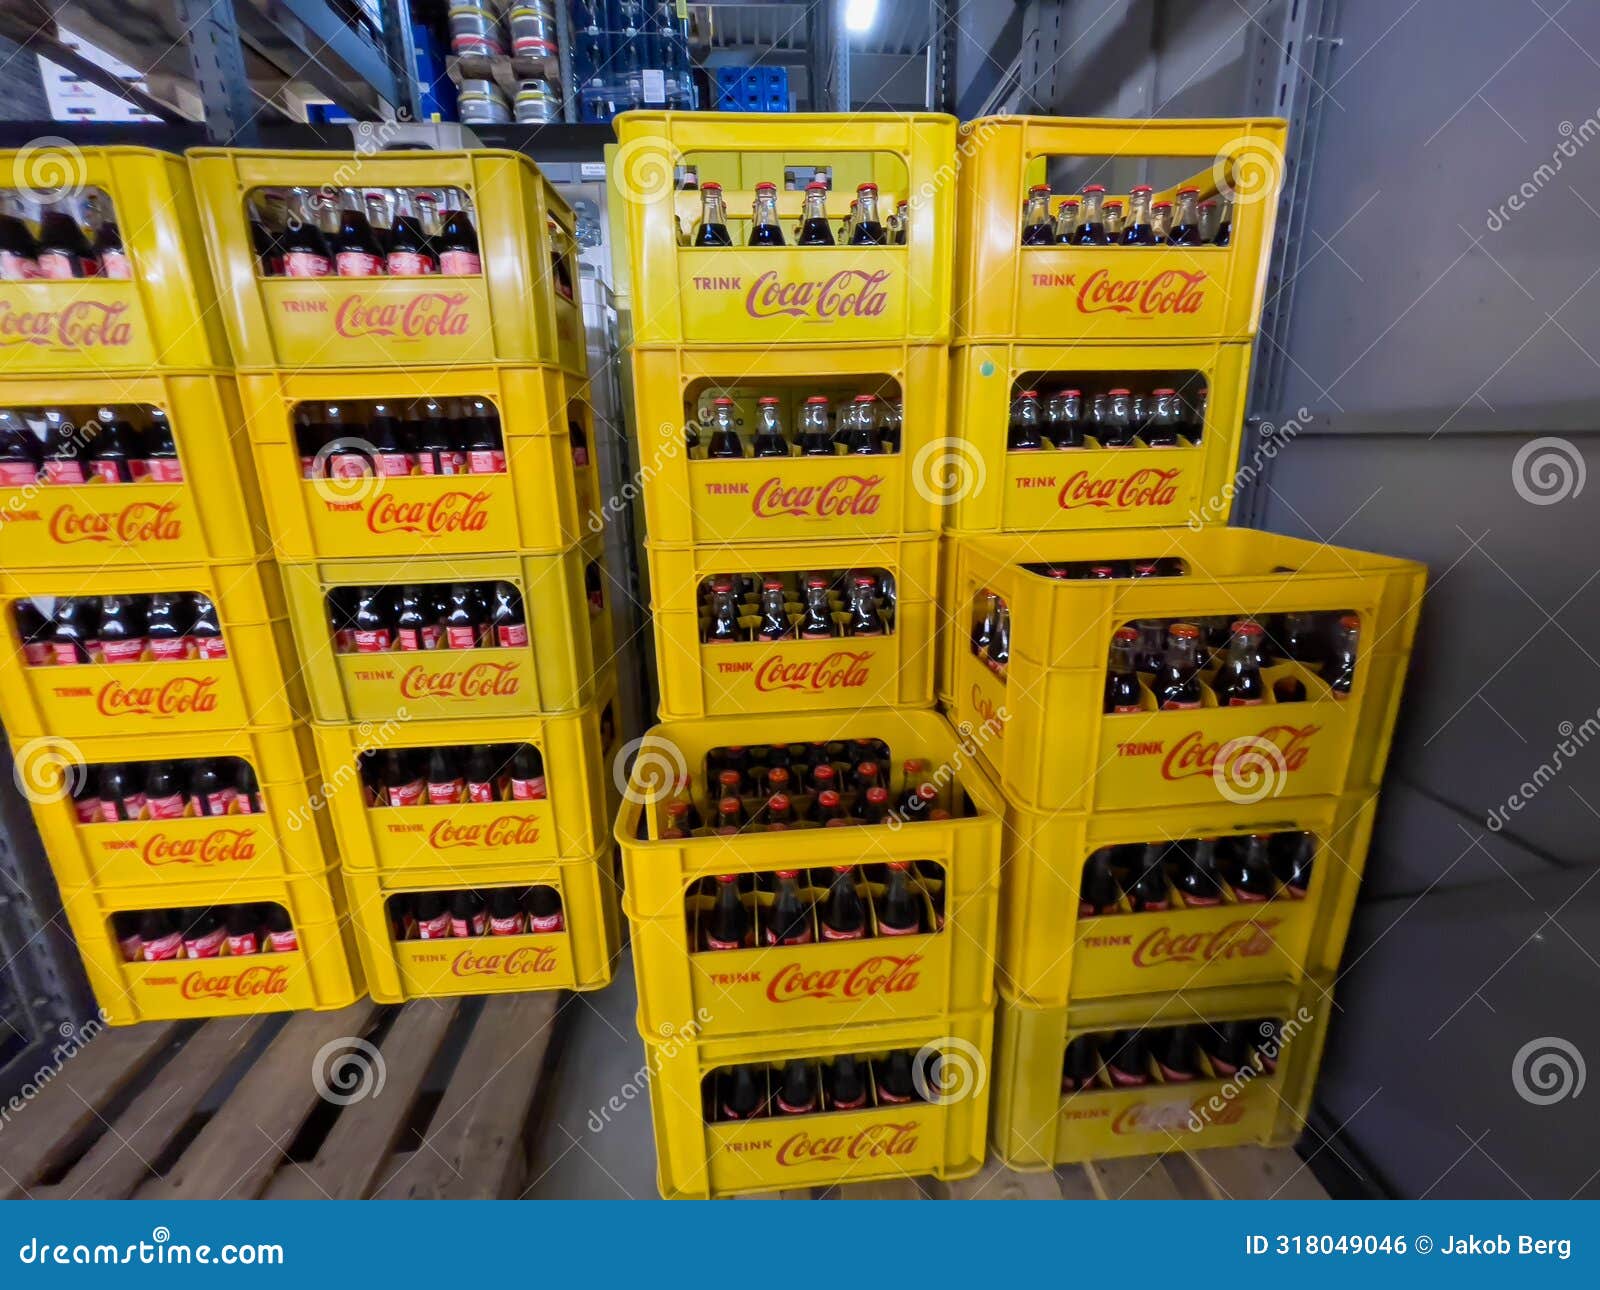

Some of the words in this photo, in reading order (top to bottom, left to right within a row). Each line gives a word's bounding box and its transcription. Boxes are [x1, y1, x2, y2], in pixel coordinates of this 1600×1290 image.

[692, 276, 742, 291] TRINK
[746, 269, 891, 319] Coca-Cola
[1032, 273, 1077, 287] TRINK
[1076, 268, 1209, 315] Coca-Cola
[0, 300, 131, 347] oca-Cola
[281, 300, 329, 313] TRINK
[335, 292, 470, 339] Coca-Cola
[705, 482, 750, 495] TRINK
[752, 474, 887, 519] Coca-Cola
[1016, 476, 1057, 489] TRINK
[1058, 467, 1184, 510] Coca-Cola
[49, 501, 183, 545] Coca-Cola
[367, 490, 493, 535] Coca-Cola
[354, 669, 395, 681] TRINK
[400, 660, 521, 700] Coca-Cola
[717, 661, 754, 674] TRINK
[754, 650, 877, 692] Coca-Cola
[97, 675, 220, 717] Coca-Cola
[1116, 740, 1166, 757] TRINK
[143, 828, 256, 866] Coca-Cola
[429, 814, 541, 849] Coca-Cola
[452, 945, 559, 977] Coca-Cola
[1083, 934, 1133, 949] TRINK
[181, 965, 289, 1000] Coca-Cola
[710, 970, 761, 985] TRINK
[766, 953, 924, 1004] Coca-Cola
[724, 1138, 773, 1153] TRINK
